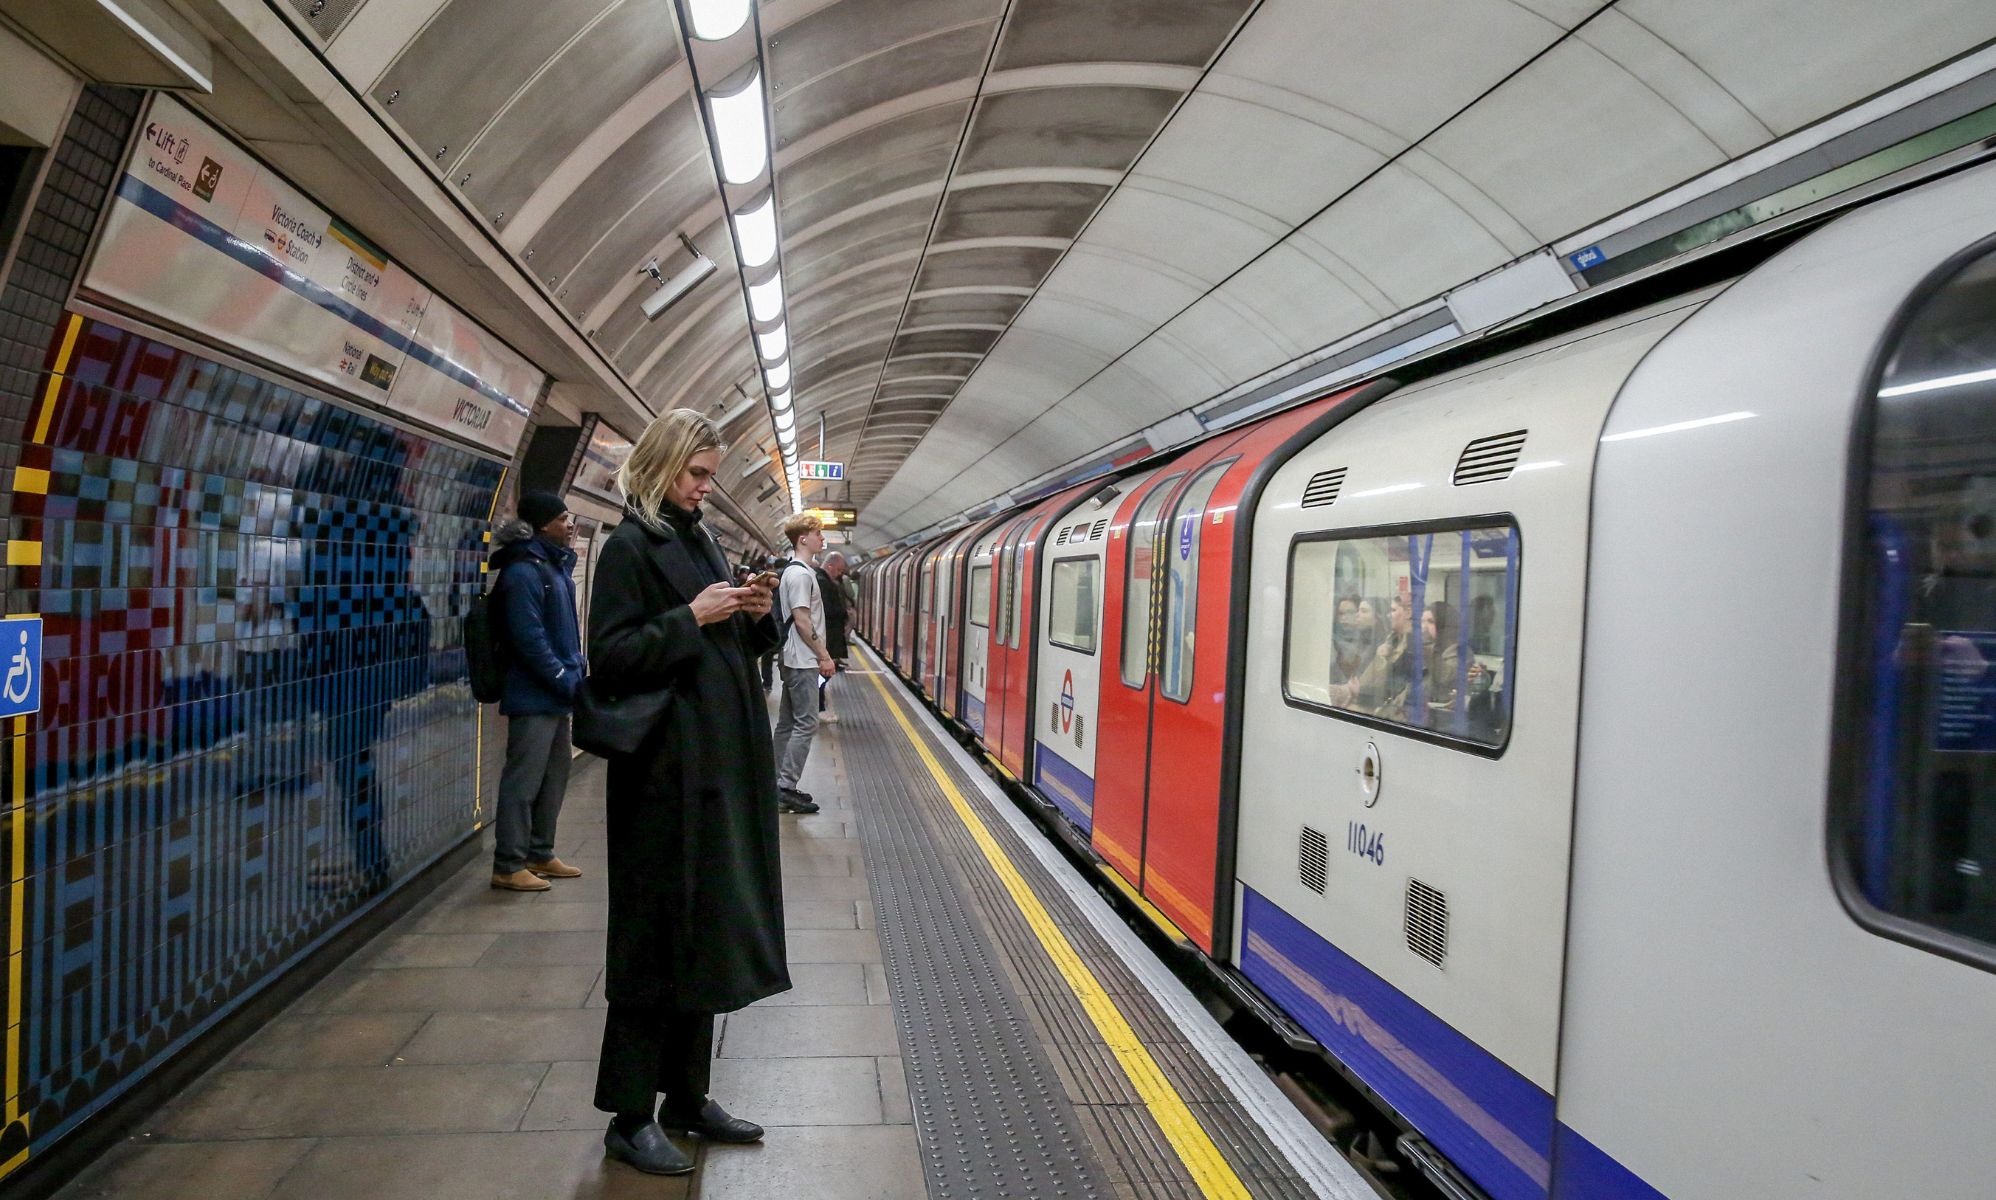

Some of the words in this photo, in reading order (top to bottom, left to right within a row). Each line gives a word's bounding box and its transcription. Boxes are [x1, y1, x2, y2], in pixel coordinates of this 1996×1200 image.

[156, 128, 175, 155] Lift
[148, 157, 156, 169] to
[156, 162, 179, 183] Cardinal
[177, 174, 192, 191] Place
[271, 204, 297, 233] Victoria
[296, 222, 316, 246] Coach
[286, 239, 309, 264] Station
[346, 256, 366, 279] District
[364, 271, 376, 285] and
[341, 275, 357, 295] Circle
[355, 285, 368, 301] lines
[343, 341, 364, 360] National
[452, 397, 487, 430] VICTORIA
[1348, 820, 1384, 866] 11046
